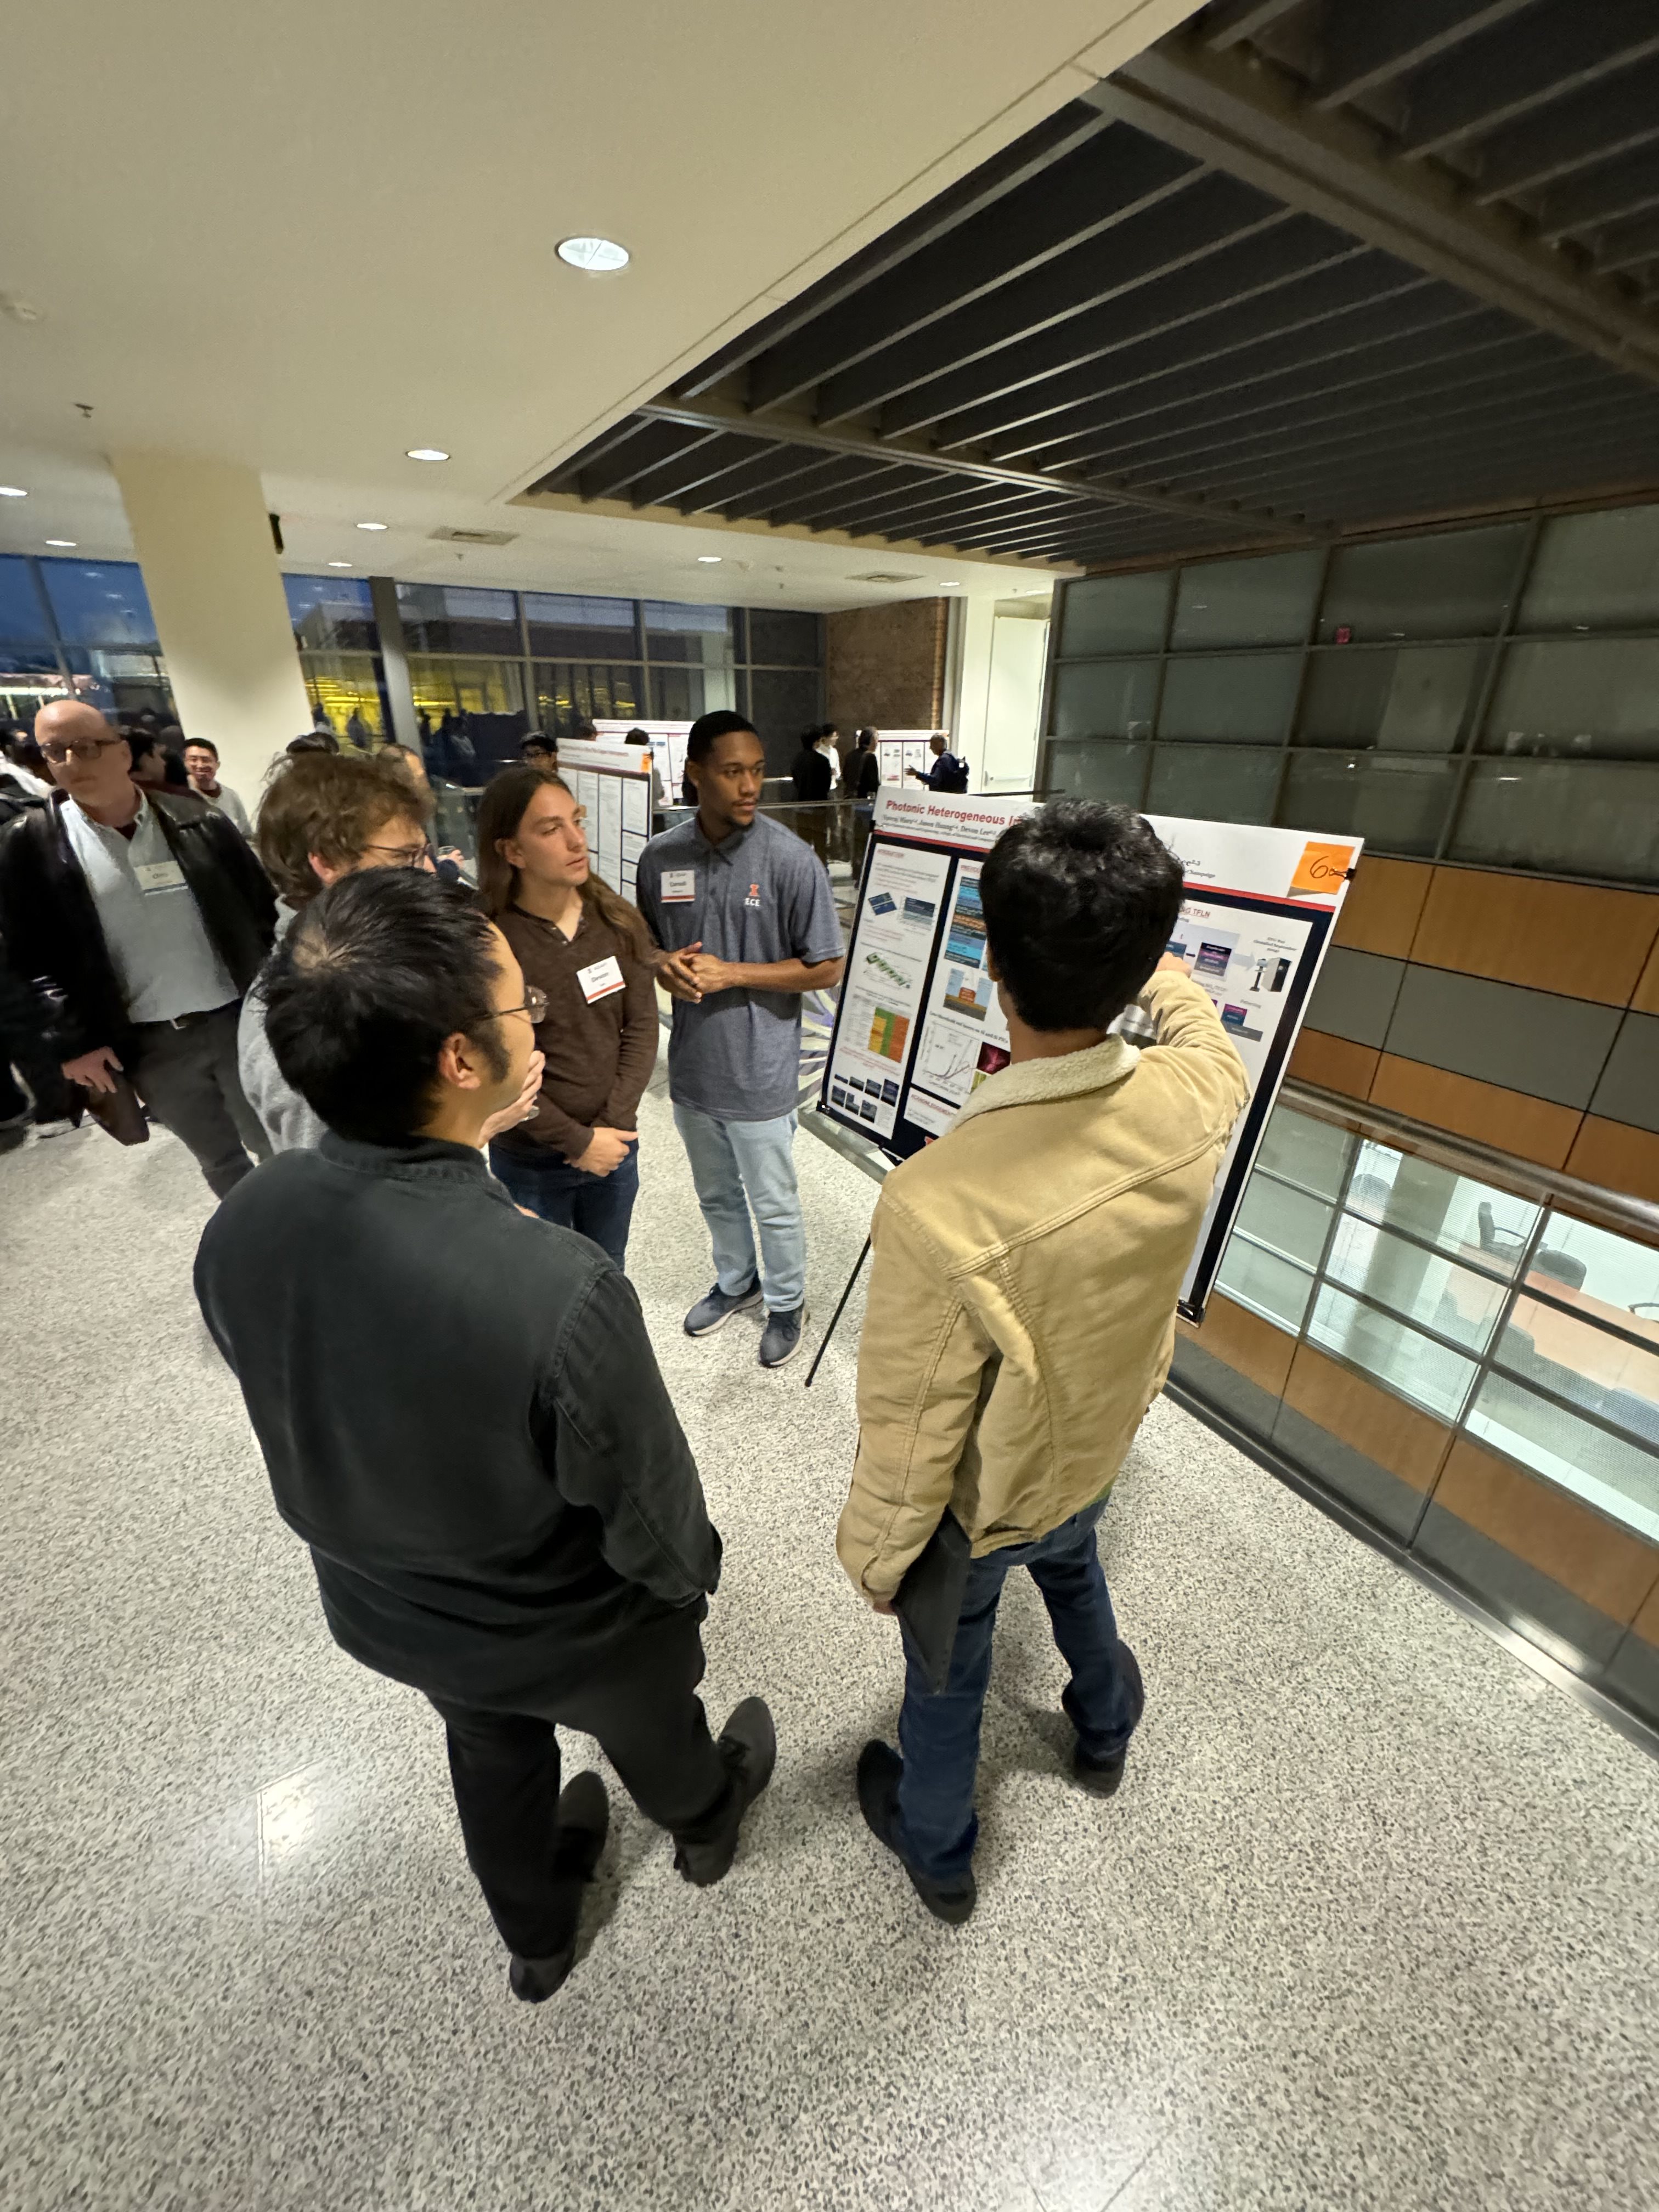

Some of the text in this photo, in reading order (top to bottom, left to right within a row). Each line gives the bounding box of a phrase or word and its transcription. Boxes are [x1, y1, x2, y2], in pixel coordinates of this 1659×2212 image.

[886, 800, 925, 814] Photonic
[927, 805, 1005, 825] Heterogeneous
[744, 898, 761, 907] ECE
